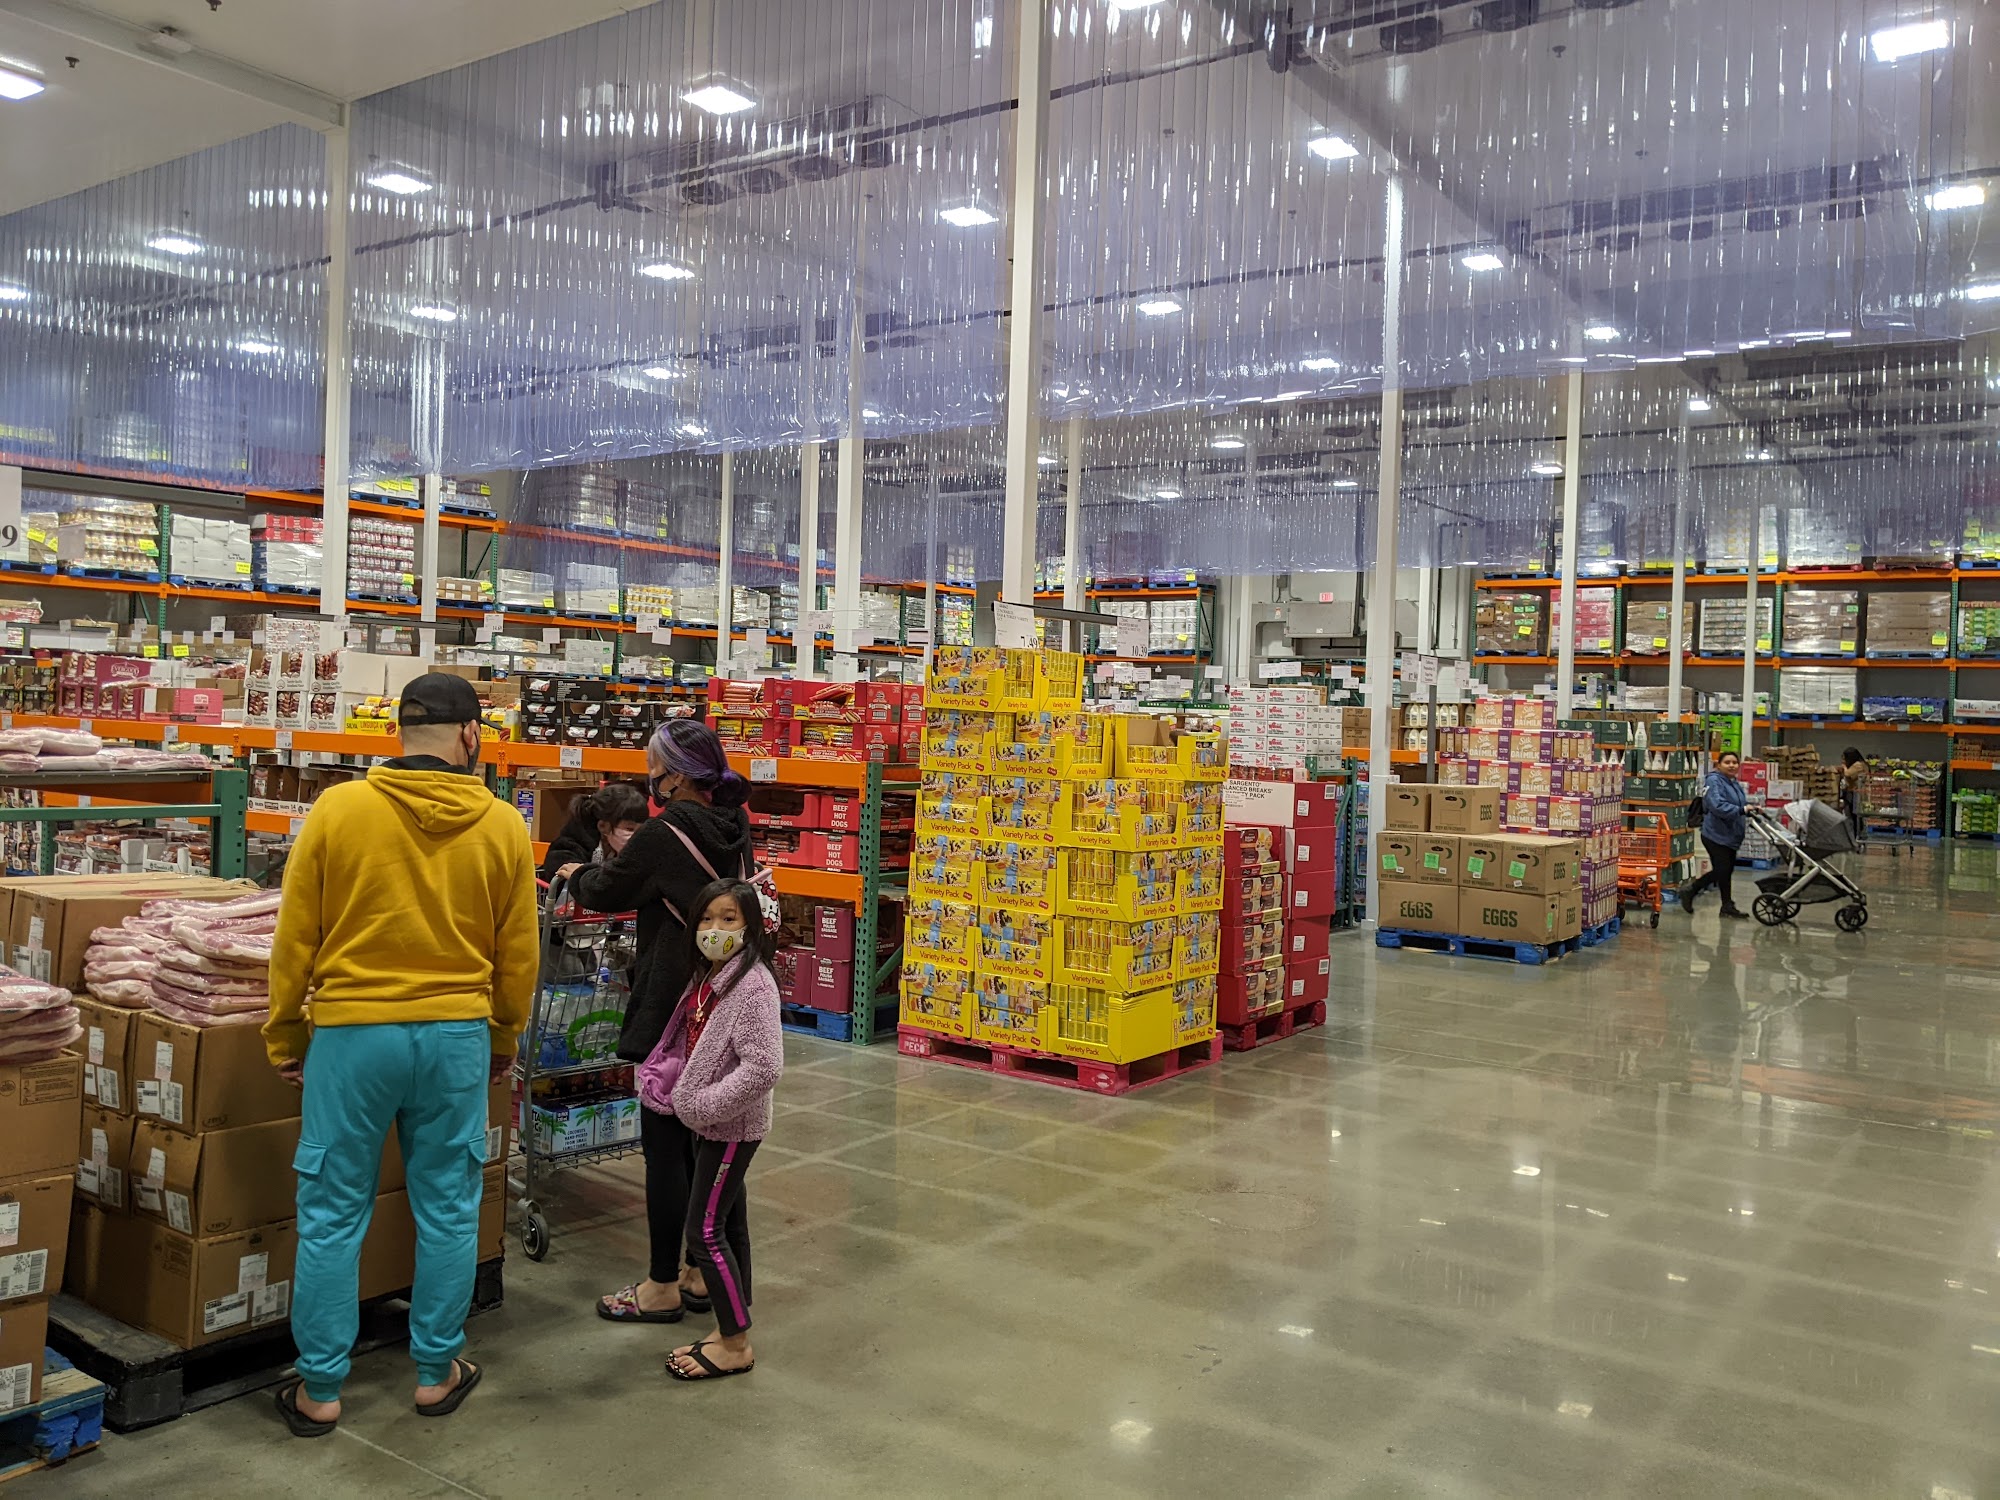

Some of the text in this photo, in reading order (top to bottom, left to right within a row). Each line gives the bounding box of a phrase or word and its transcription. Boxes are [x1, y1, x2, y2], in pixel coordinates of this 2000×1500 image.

[1321, 593, 1331, 601] EXIT
[1021, 636, 1038, 648] 7.49
[1132, 645, 1148, 657] 10.39
[940, 697, 975, 707] Variety Pack
[1523, 706, 1535, 714] Silk
[1478, 735, 1490, 743] Silk
[1470, 749, 1497, 757] OATMILK
[1511, 750, 1539, 759] OATMILK
[936, 760, 971, 770] Variety Pack
[1447, 765, 1459, 773] Silk
[1005, 765, 1043, 775] Variety Pack
[1135, 767, 1154, 775] Variety
[1200, 770, 1211, 778] Variety
[1487, 767, 1500, 775] Silk
[1530, 769, 1542, 778] Silk
[1521, 783, 1550, 792] OATMILK
[1516, 801, 1528, 809] Silk
[1558, 804, 1571, 813] Silk
[1480, 804, 1492, 821] EGGS
[1507, 815, 1536, 824] OATMILK
[1549, 817, 1579, 826] OATMILK
[931, 823, 966, 833] Variety Pack
[1002, 830, 1039, 840] Variety Pack
[1191, 835, 1204, 843] Variety
[1078, 836, 1112, 845] Variety Pack
[1145, 838, 1158, 847] Variety
[1553, 862, 1566, 880] EGGS
[924, 887, 959, 898] Variety Pack
[997, 896, 1034, 907] Variety Pack
[1190, 900, 1203, 908] Variety
[1075, 905, 1109, 915] Variety Pack
[1143, 906, 1167, 916] Variety Pack
[1400, 900, 1433, 919] EGGS
[1483, 908, 1518, 927] EGGS
[1566, 907, 1575, 925] EGGS
[920, 950, 955, 964] Variety Pack
[992, 962, 1030, 976] Variety Pack
[1189, 966, 1201, 974] Variety
[1072, 974, 1105, 985] Variety Pack
[1139, 978, 1153, 986] Variety
[916, 1015, 951, 1029] Variety Pack
[989, 1029, 1027, 1043] Variety Pack
[1183, 1033, 1196, 1041] Variety
[1065, 1044, 1099, 1056] Variety Pack
